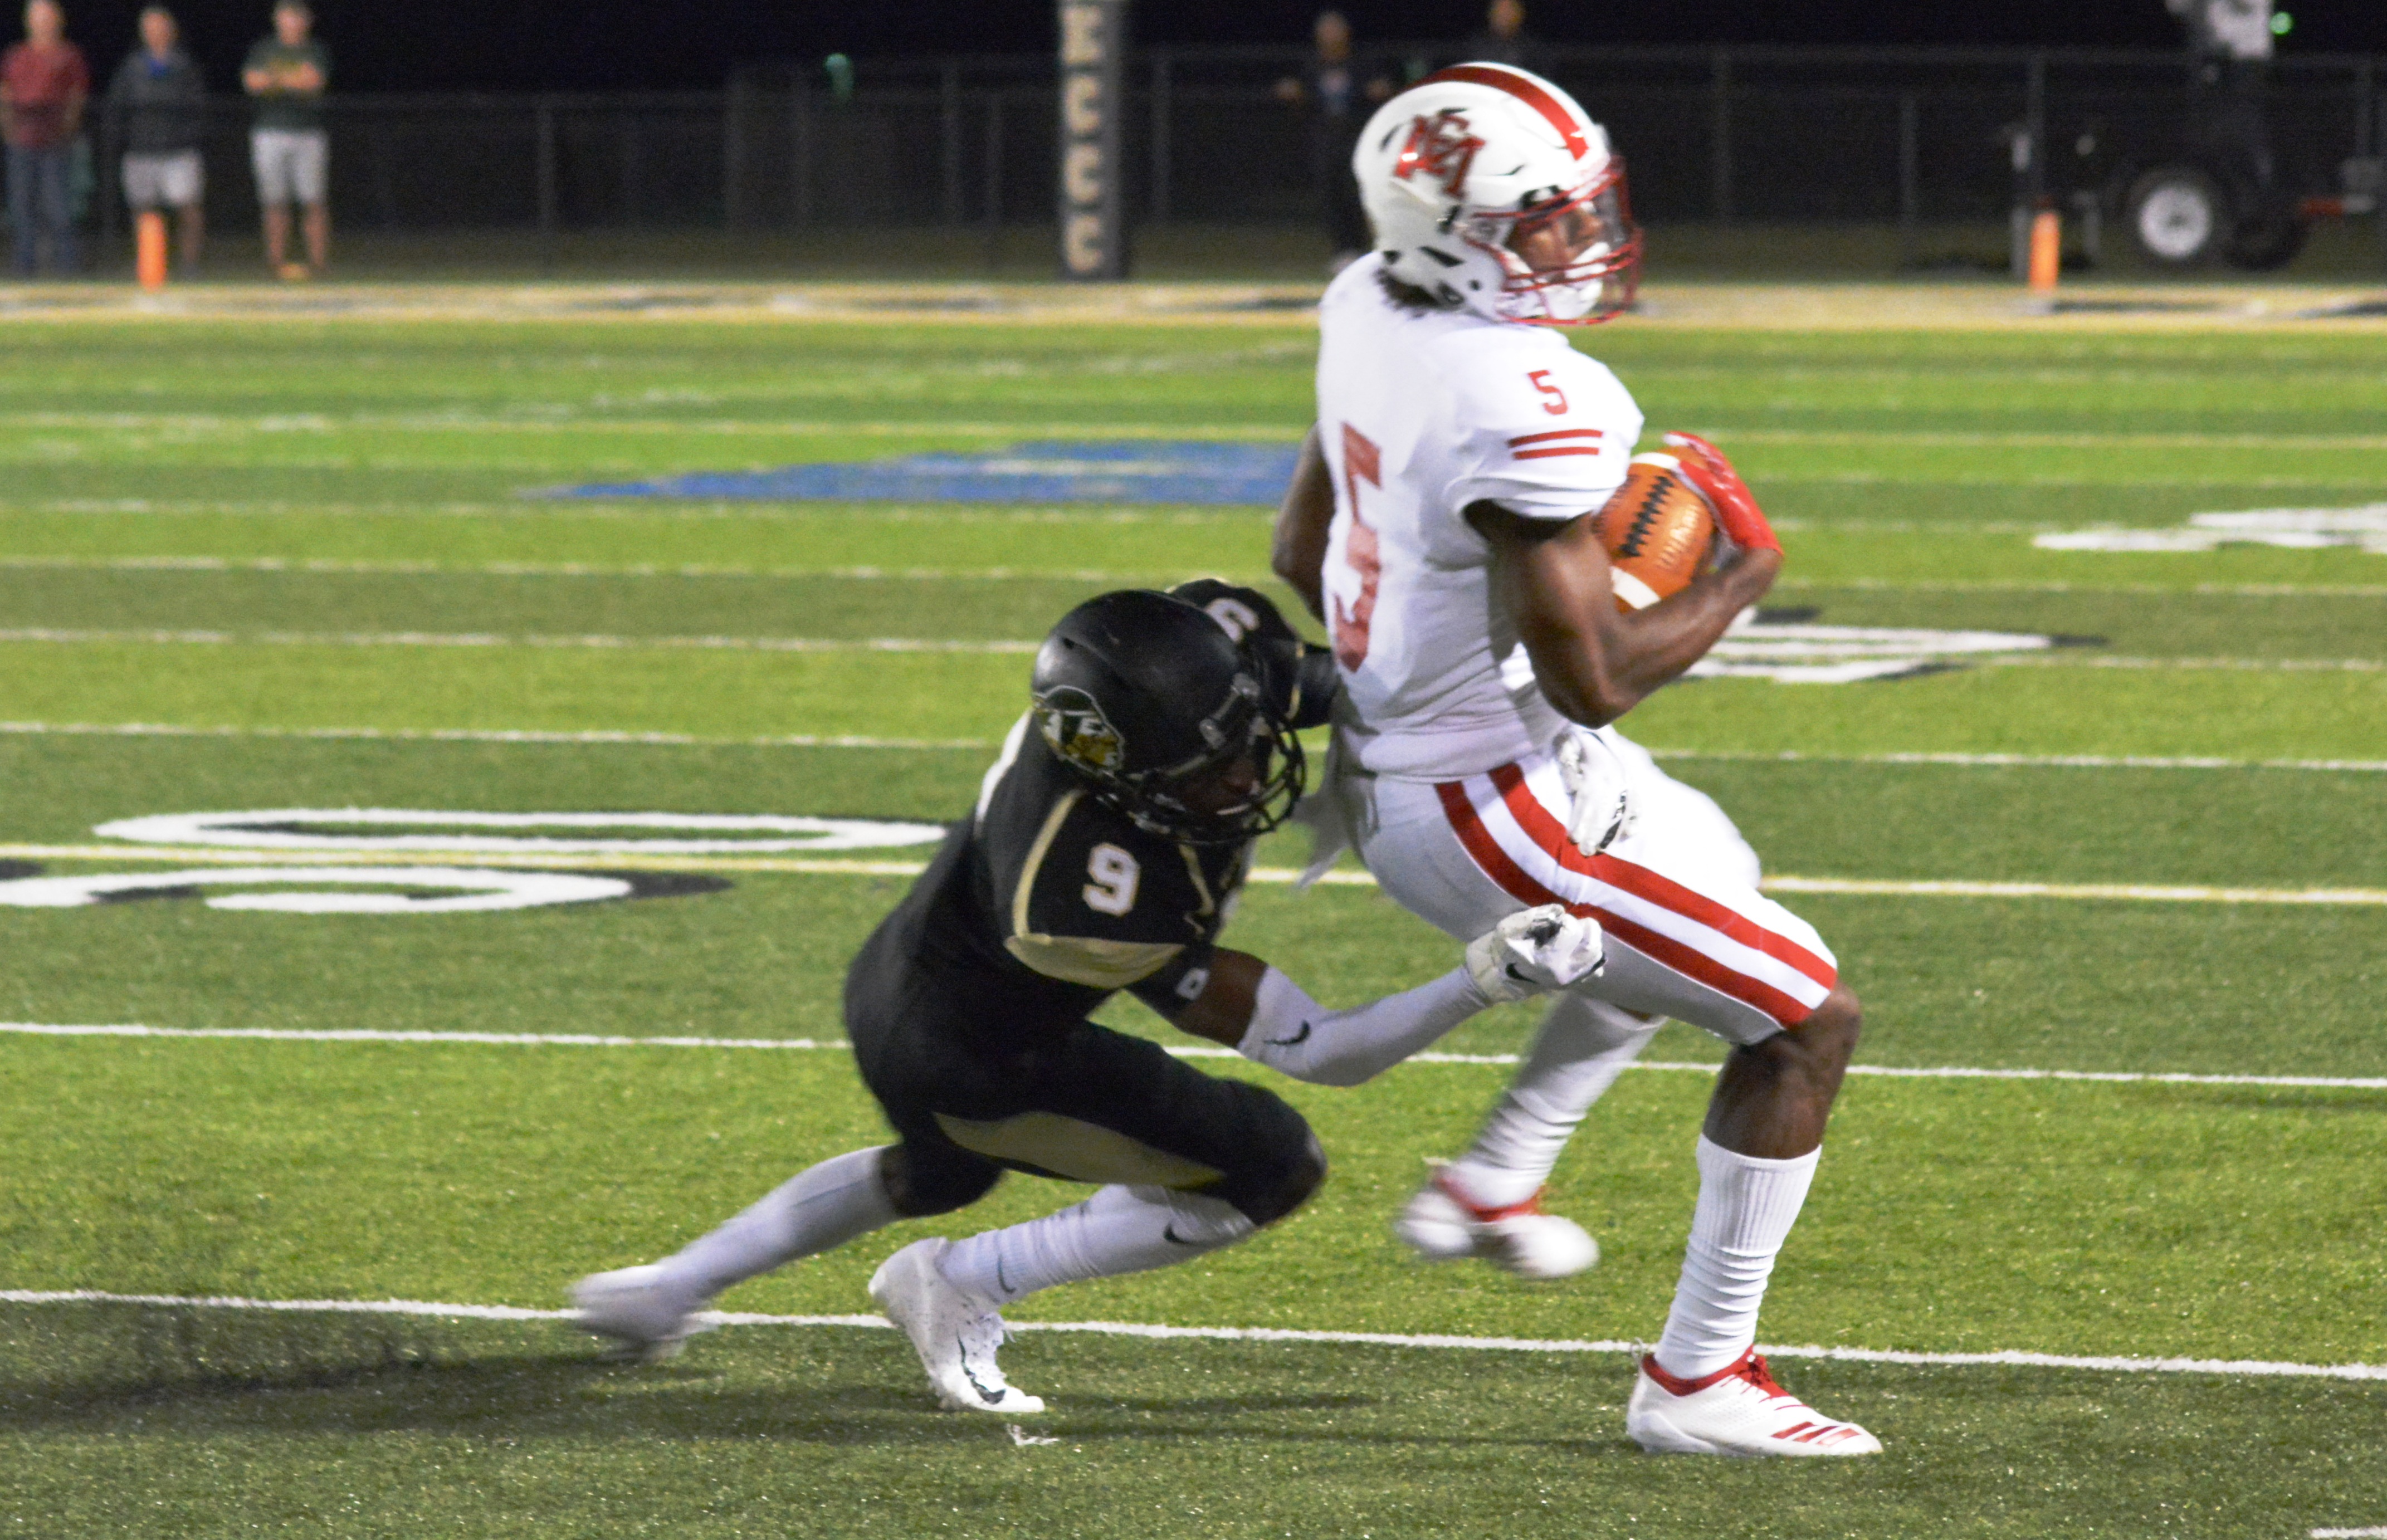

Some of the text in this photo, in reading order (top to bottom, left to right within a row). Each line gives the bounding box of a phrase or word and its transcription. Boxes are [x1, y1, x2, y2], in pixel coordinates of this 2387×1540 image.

[1527, 370, 1569, 415] 5
[1334, 422, 1382, 672] 5
[1082, 843, 1140, 917] 9
